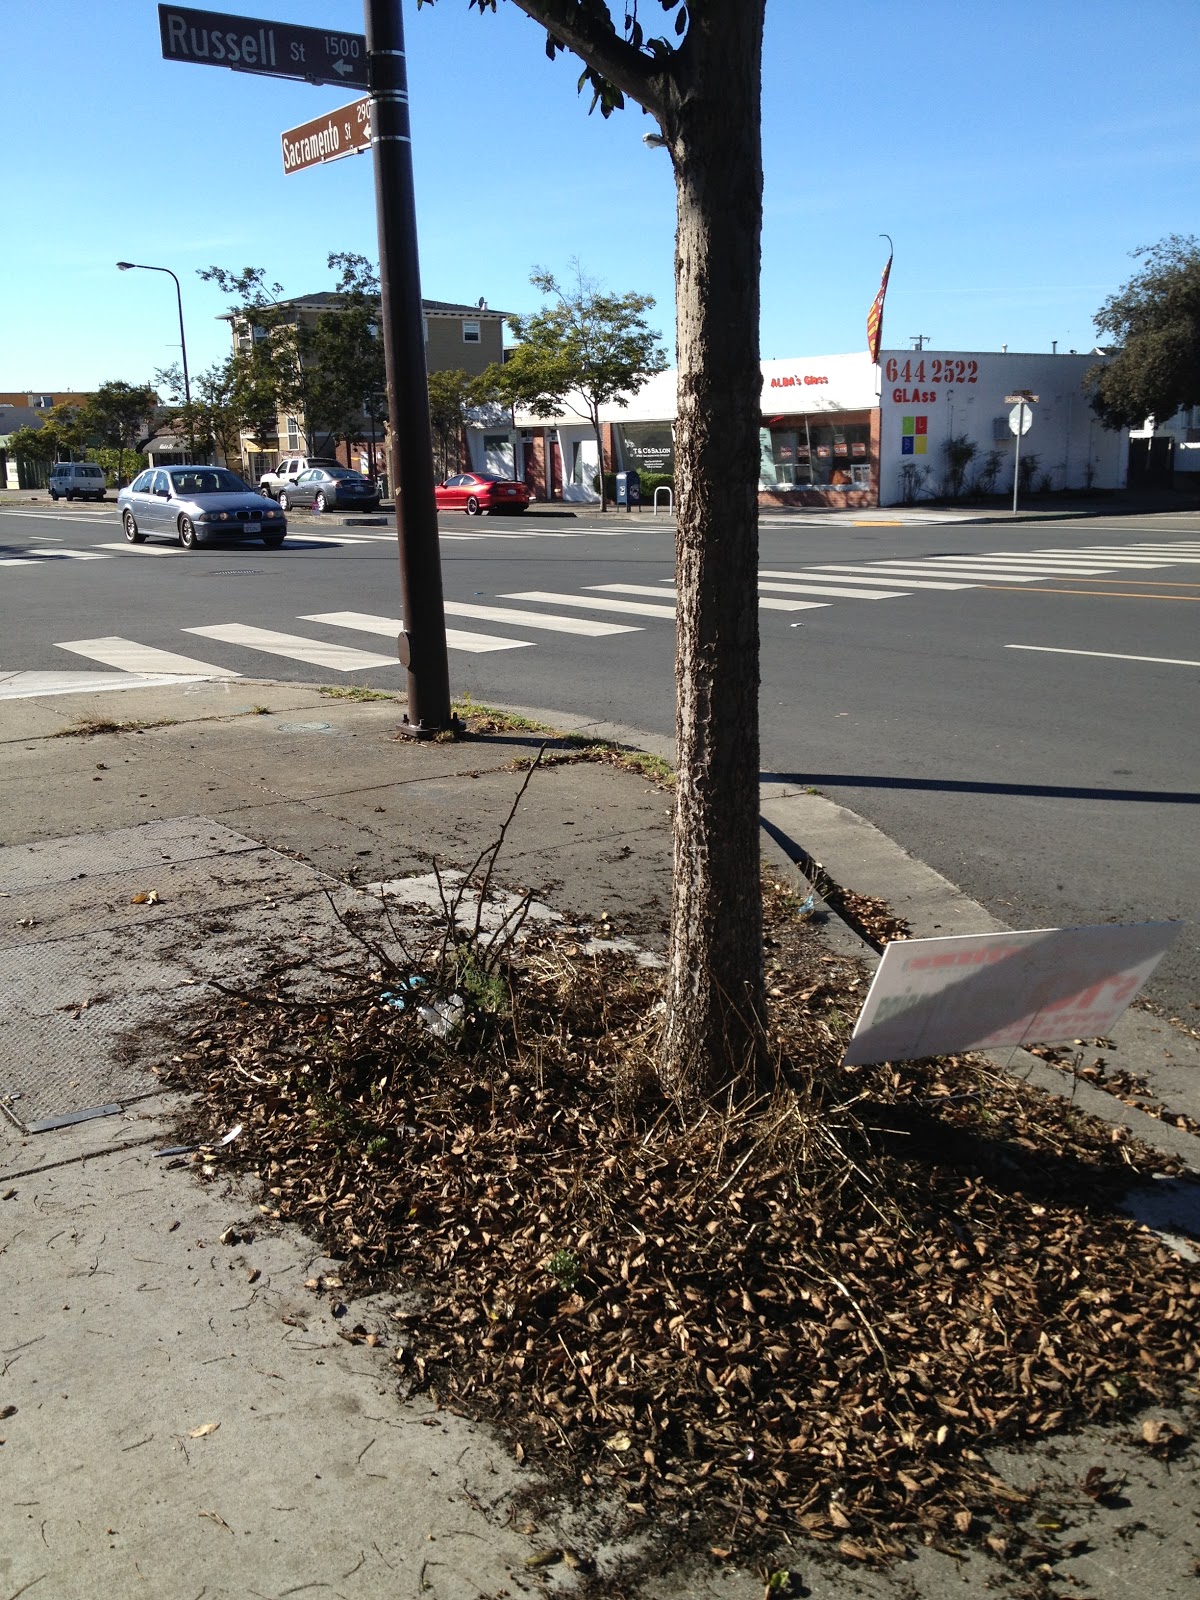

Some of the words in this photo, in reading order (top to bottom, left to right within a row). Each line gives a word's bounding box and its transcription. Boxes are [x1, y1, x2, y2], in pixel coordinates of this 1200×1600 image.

[167, 14, 276, 66] Russell
[290, 42, 305, 62] St
[325, 36, 359, 58] 1500
[283, 120, 339, 169] Sacramento
[344, 122, 351, 140] St
[356, 101, 370, 123] 290
[886, 358, 926, 382] 644
[931, 359, 978, 383] 2522
